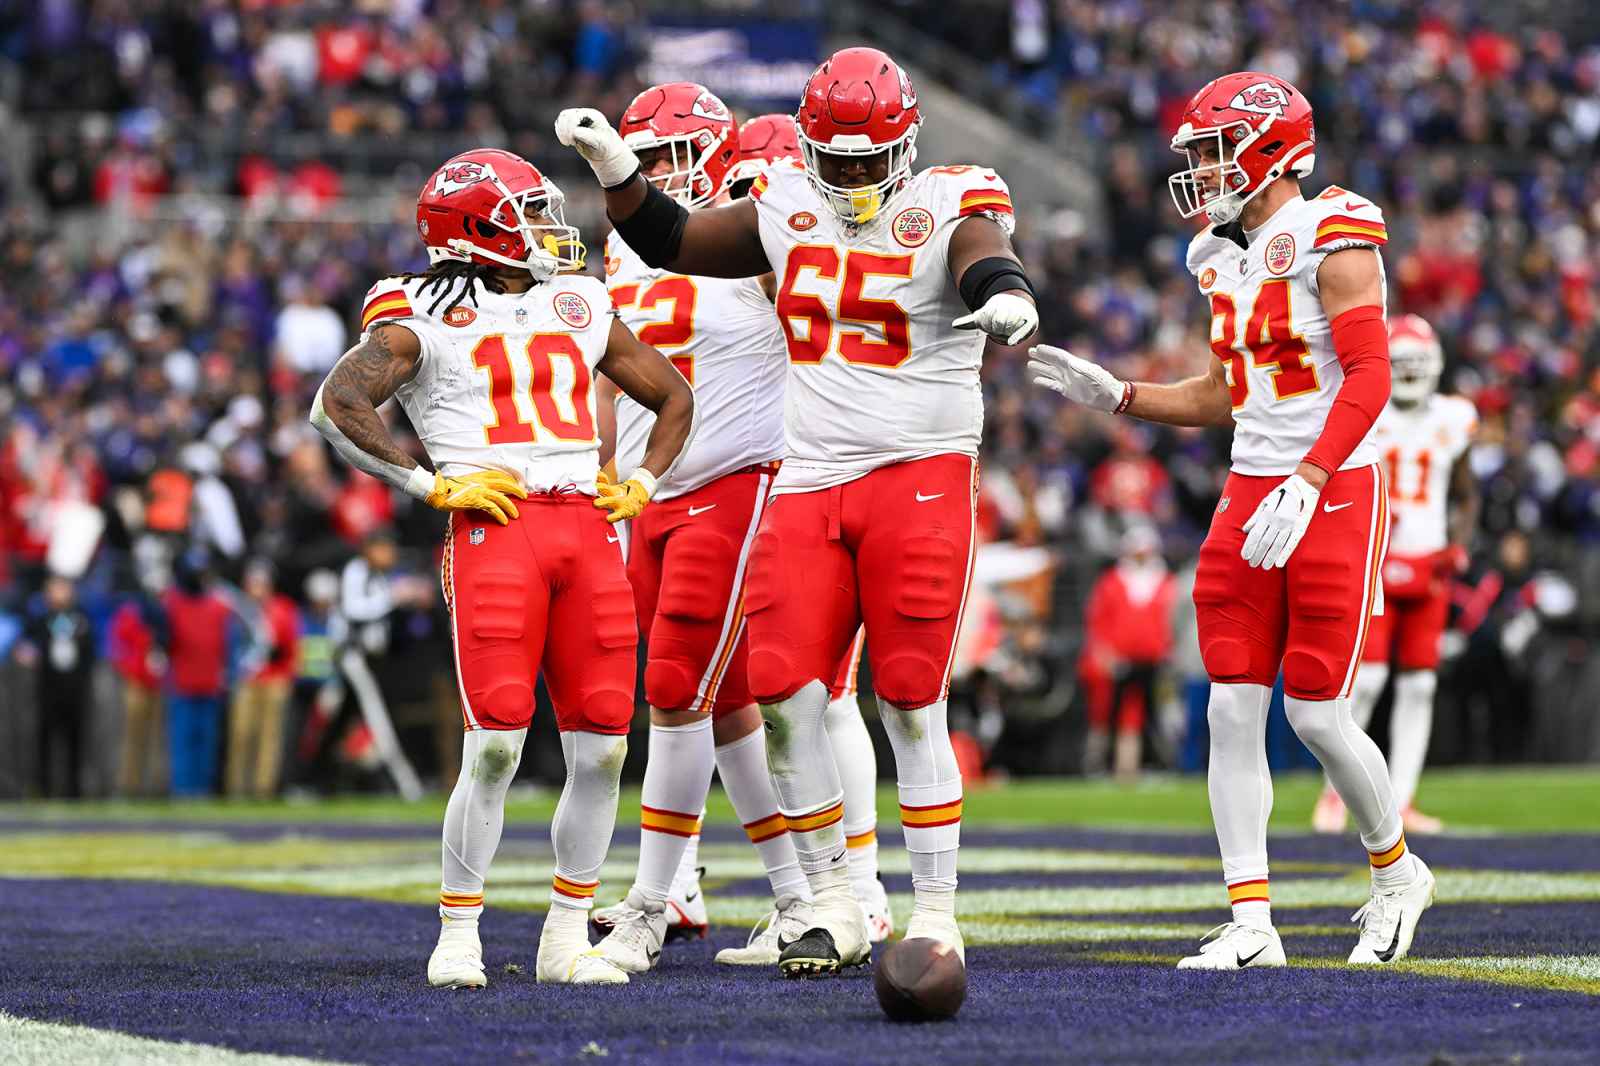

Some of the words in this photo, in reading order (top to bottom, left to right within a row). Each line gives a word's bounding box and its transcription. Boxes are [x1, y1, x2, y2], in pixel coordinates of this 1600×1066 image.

[450, 311, 470, 323] NKH
[608, 275, 698, 389] 2
[776, 243, 914, 368] 65
[1210, 279, 1320, 411] 84
[471, 332, 597, 445] 10
[1385, 445, 1431, 503] 11
